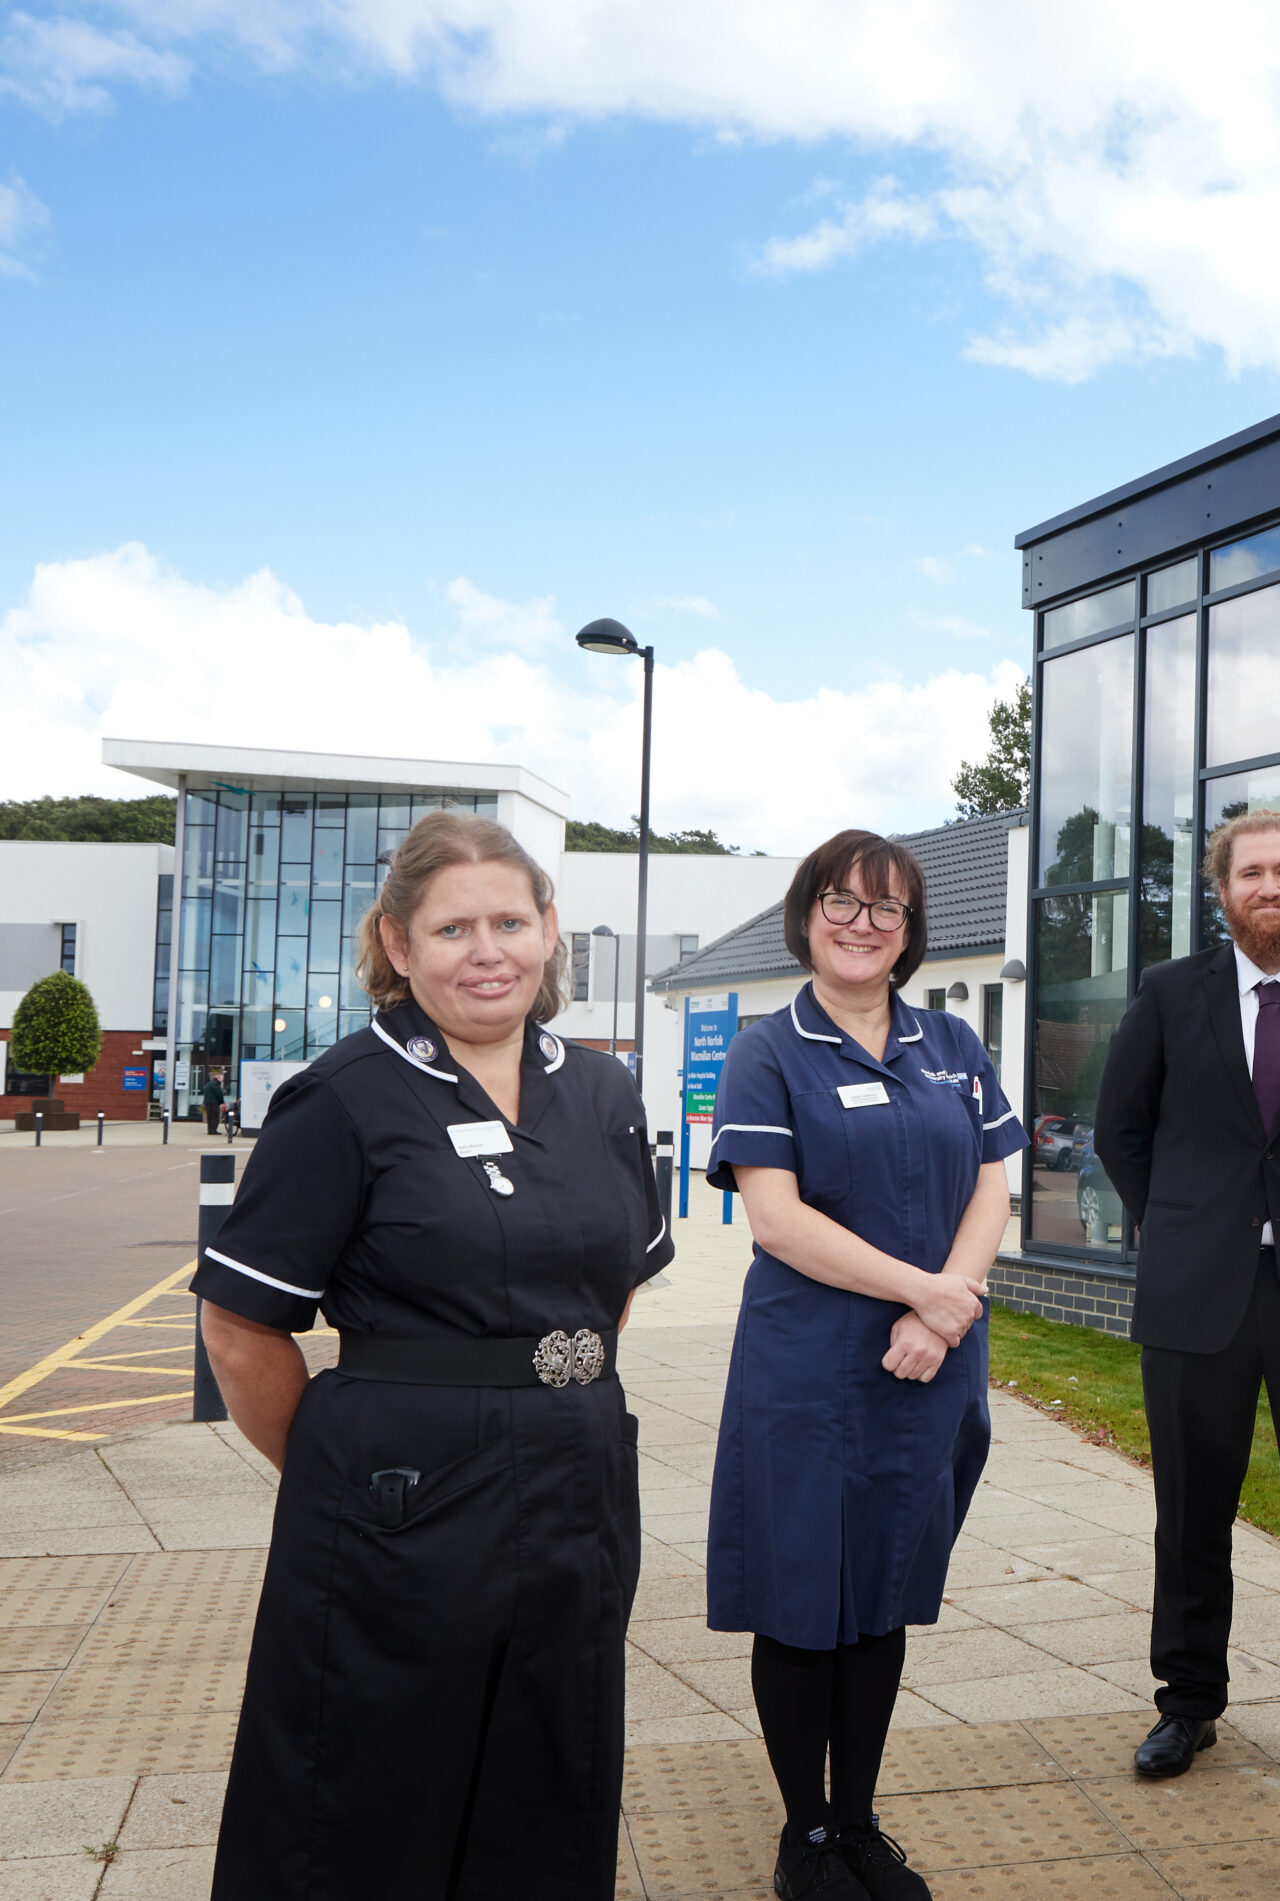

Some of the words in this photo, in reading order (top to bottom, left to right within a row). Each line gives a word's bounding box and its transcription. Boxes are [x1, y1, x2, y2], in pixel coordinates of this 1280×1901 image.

[694, 1036, 706, 1046] North
[707, 1034, 723, 1046] Norfolk
[691, 1050, 711, 1061] Macmillan
